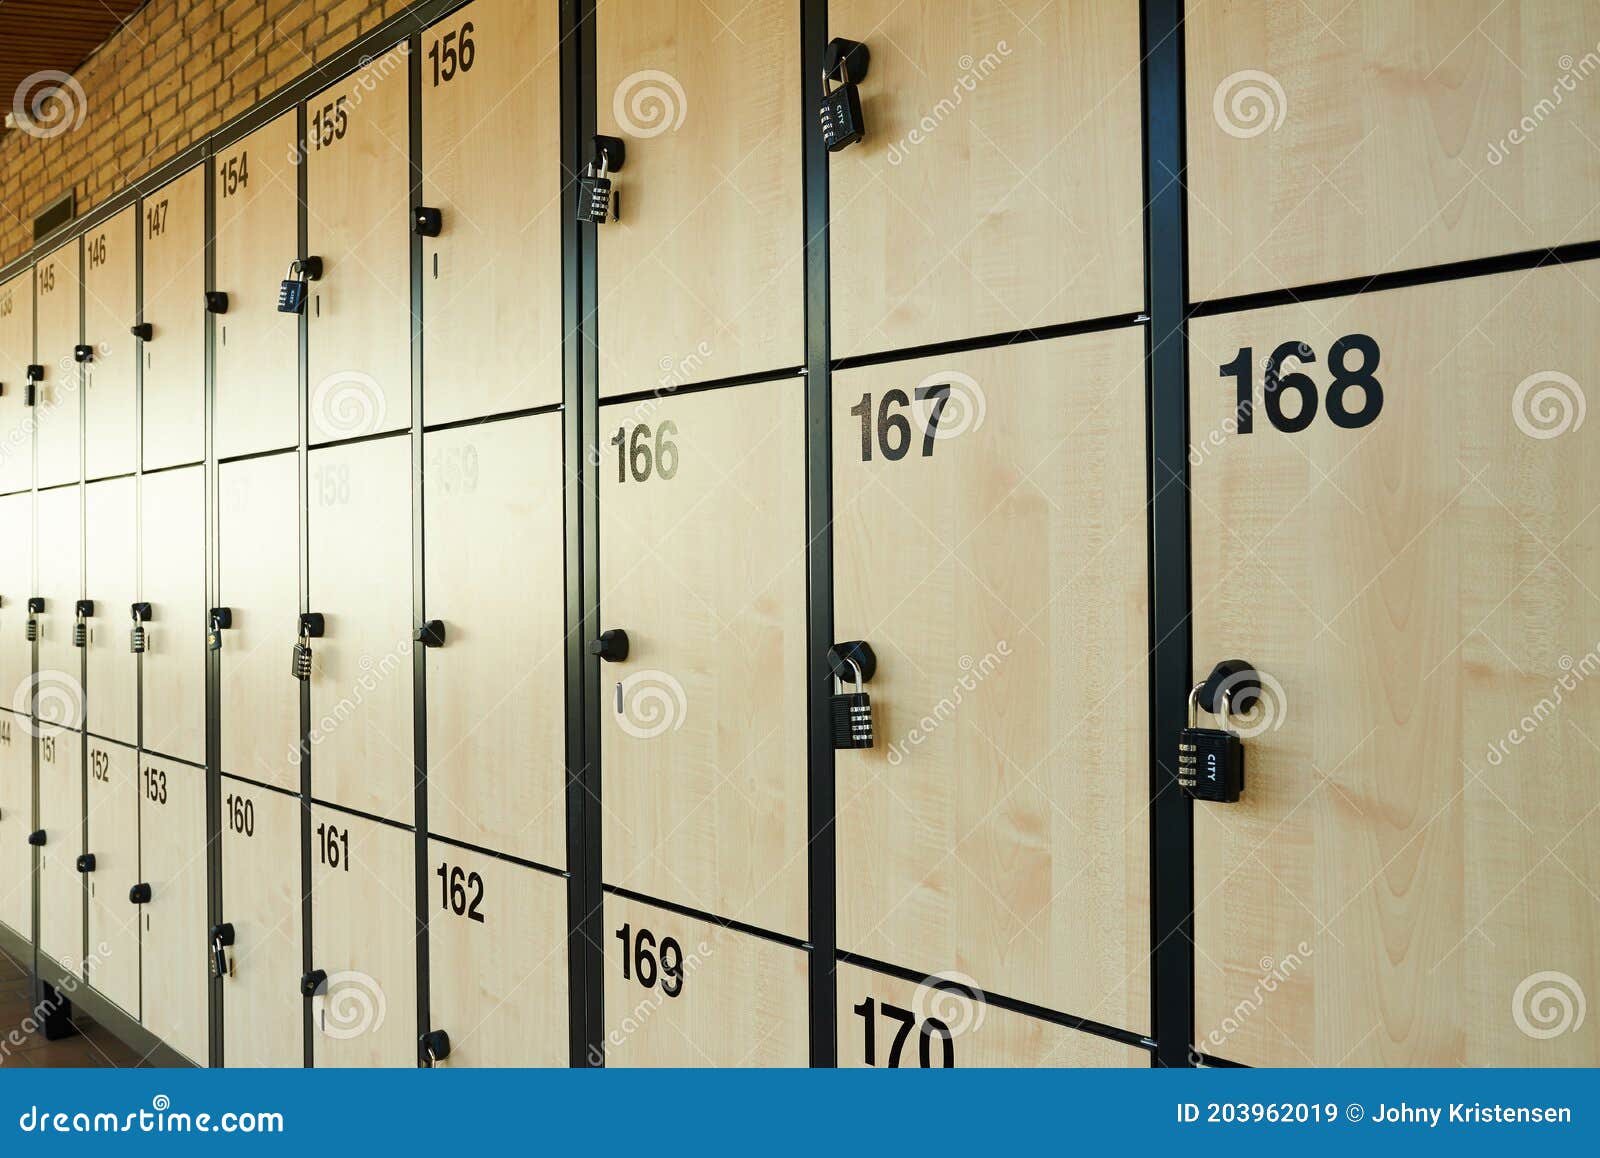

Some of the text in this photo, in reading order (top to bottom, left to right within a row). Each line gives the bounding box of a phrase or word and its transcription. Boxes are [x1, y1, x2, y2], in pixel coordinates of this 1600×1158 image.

[428, 21, 475, 87] 156
[312, 95, 348, 151] 155
[836, 104, 845, 125] CITY
[220, 151, 249, 198] 154
[146, 198, 169, 240] 147
[88, 233, 106, 271] 146
[39, 263, 55, 296] 145
[1219, 333, 1384, 435] 168
[850, 383, 951, 462] 167
[611, 419, 679, 484] 166
[41, 735, 56, 764] 151
[90, 749, 109, 783] 152
[1207, 753, 1217, 782] CITY
[143, 767, 168, 805] 153
[226, 794, 254, 837] 160
[317, 823, 350, 872] 161
[437, 862, 485, 924] 162
[615, 923, 684, 998] 169
[853, 996, 954, 1068] 170
